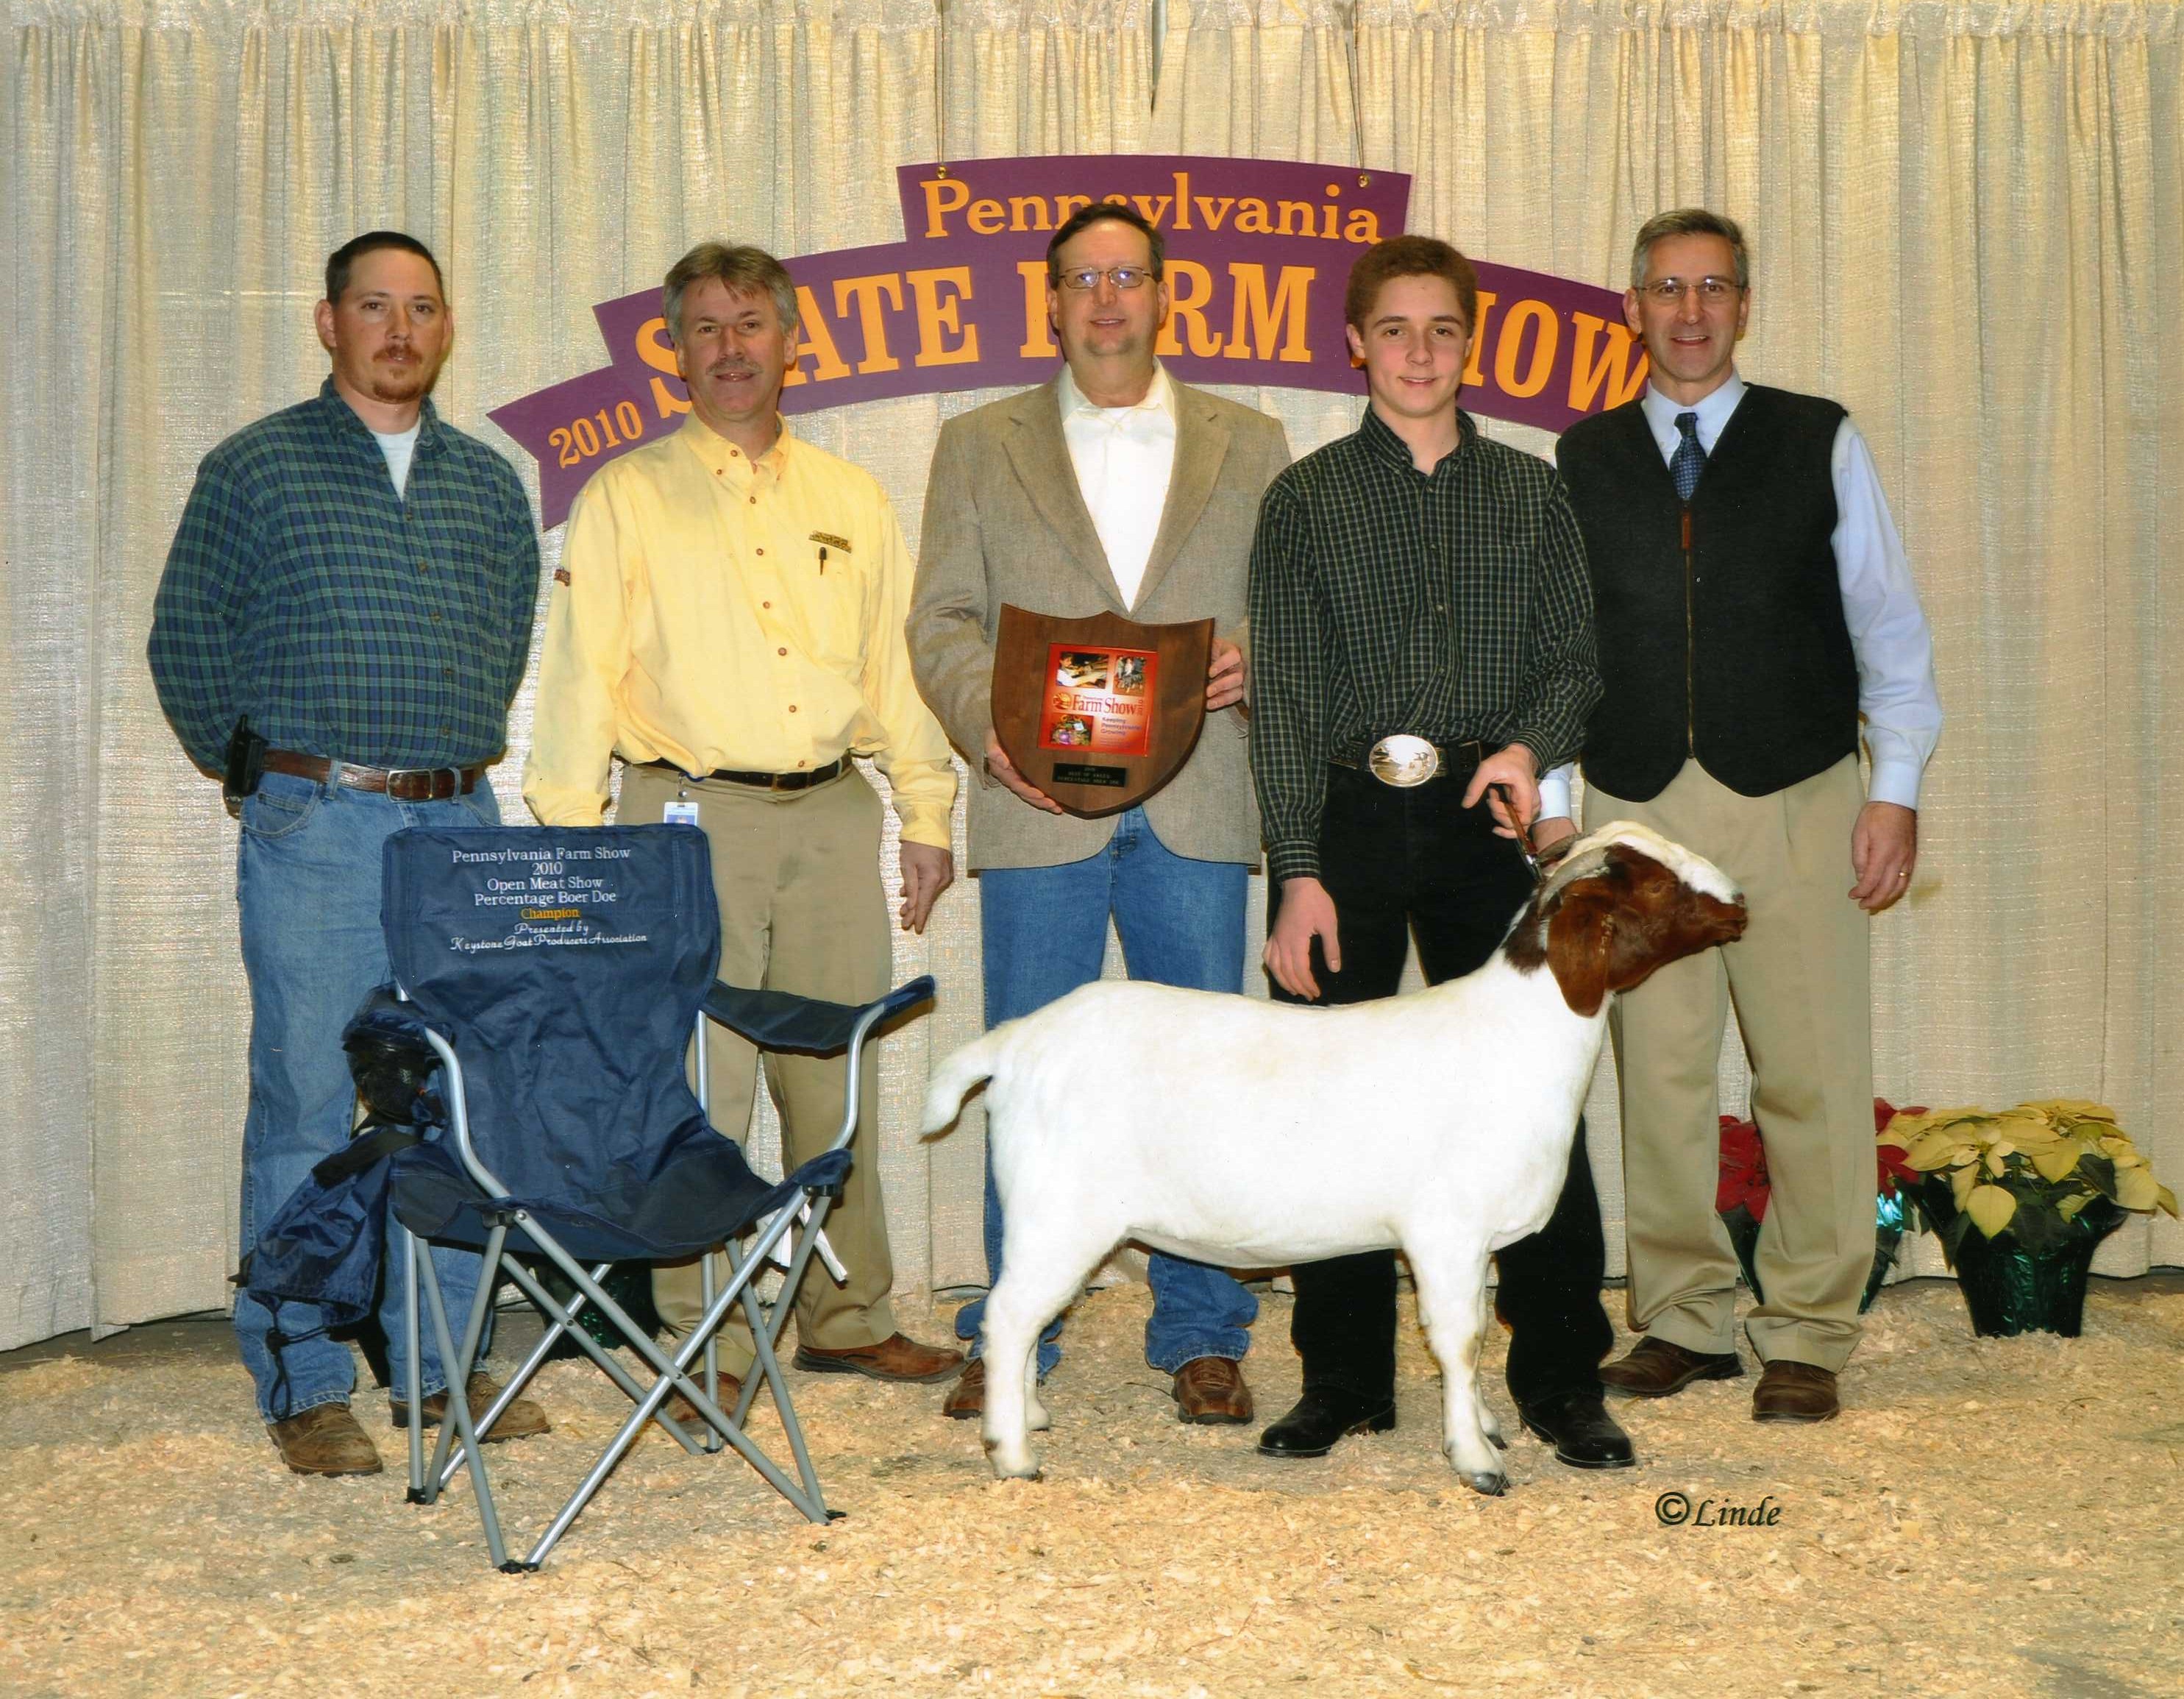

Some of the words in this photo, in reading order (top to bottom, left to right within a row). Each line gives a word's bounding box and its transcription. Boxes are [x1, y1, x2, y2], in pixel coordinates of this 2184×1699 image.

[920, 171, 1383, 244] Pennylvania
[548, 401, 643, 469] 2010
[1072, 694, 1102, 712] Farm
[1104, 697, 1138, 715] Show
[452, 848, 551, 865] Pennsylvania
[556, 847, 592, 860] Farm
[594, 846, 631, 859] Show
[532, 862, 563, 876] 2010
[487, 878, 525, 894] Open
[530, 877, 565, 890] Meat
[568, 876, 604, 889] Show
[474, 893, 555, 907] Percentage
[558, 891, 588, 904] Boer
[592, 890, 616, 903] Doe
[521, 907, 580, 921] Champion
[514, 921, 573, 934] Presented
[576, 920, 589, 936] by
[450, 937, 503, 954] Keystone
[504, 934, 533, 951] Goat
[533, 933, 588, 946] Producers
[588, 932, 648, 945] Association
